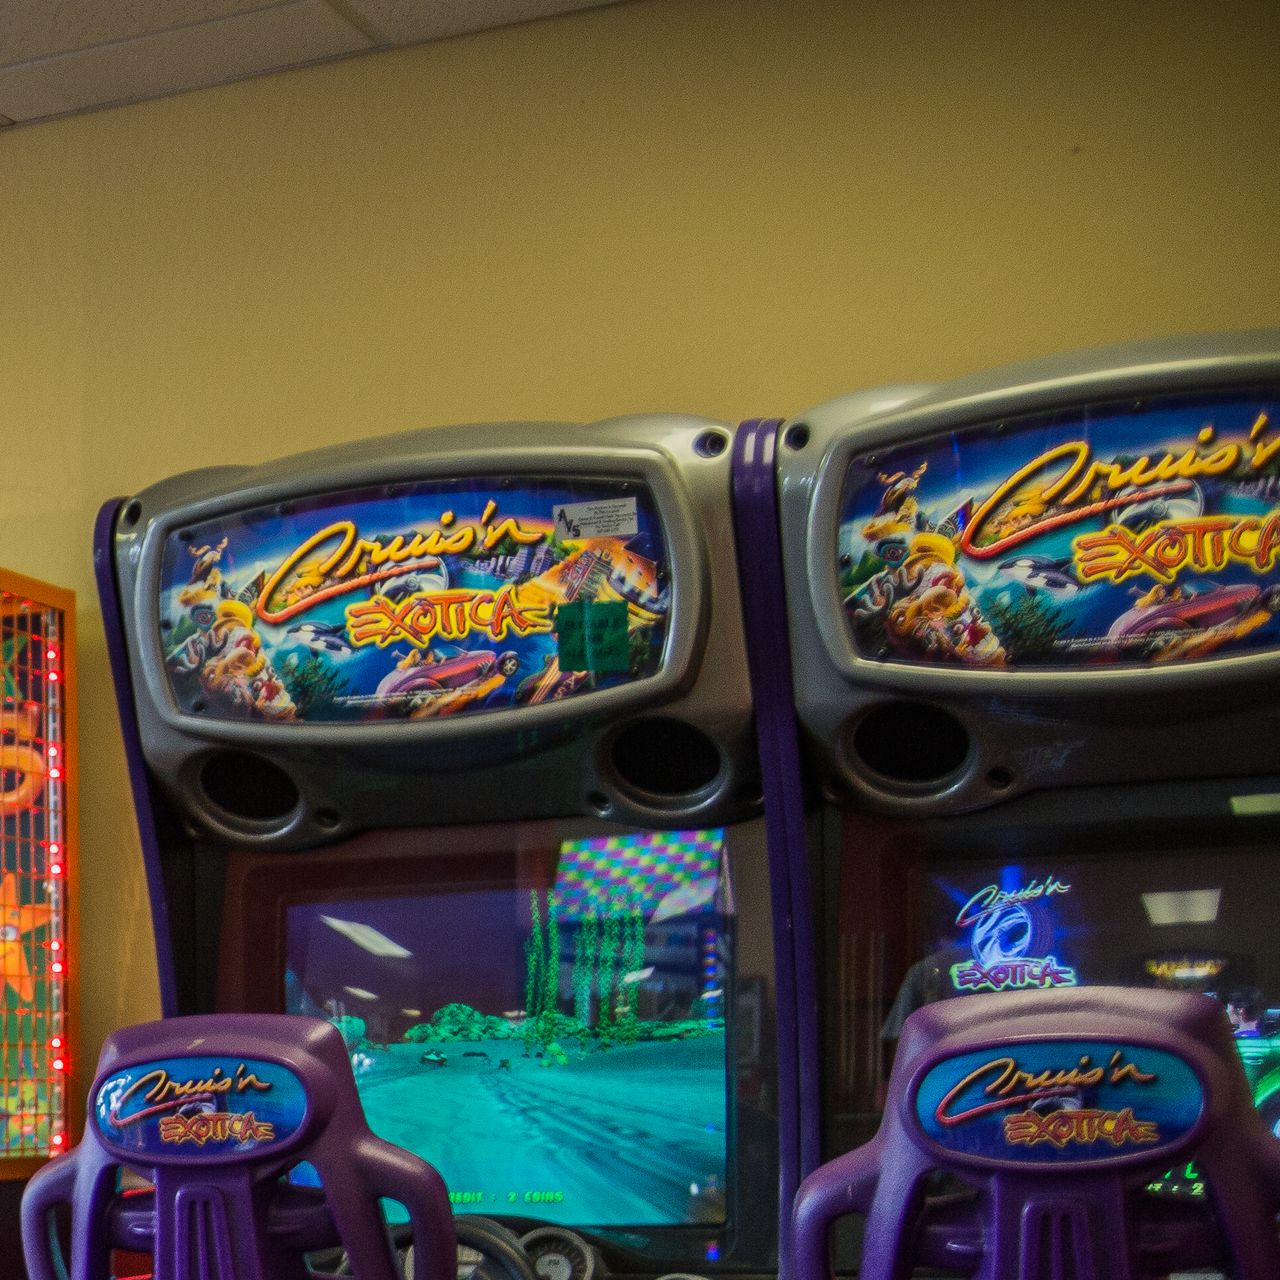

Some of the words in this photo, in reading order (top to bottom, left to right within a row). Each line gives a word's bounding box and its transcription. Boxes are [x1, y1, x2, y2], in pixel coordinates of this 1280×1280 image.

[255, 500, 544, 624] Cruis'n
[347, 587, 553, 647] EXOTICA
[953, 956, 1077, 991] EXOTICA
[159, 1111, 276, 1145] EXOTICA
[1002, 1109, 1160, 1148] EXOTICA
[524, 1191, 564, 1204] COINS
